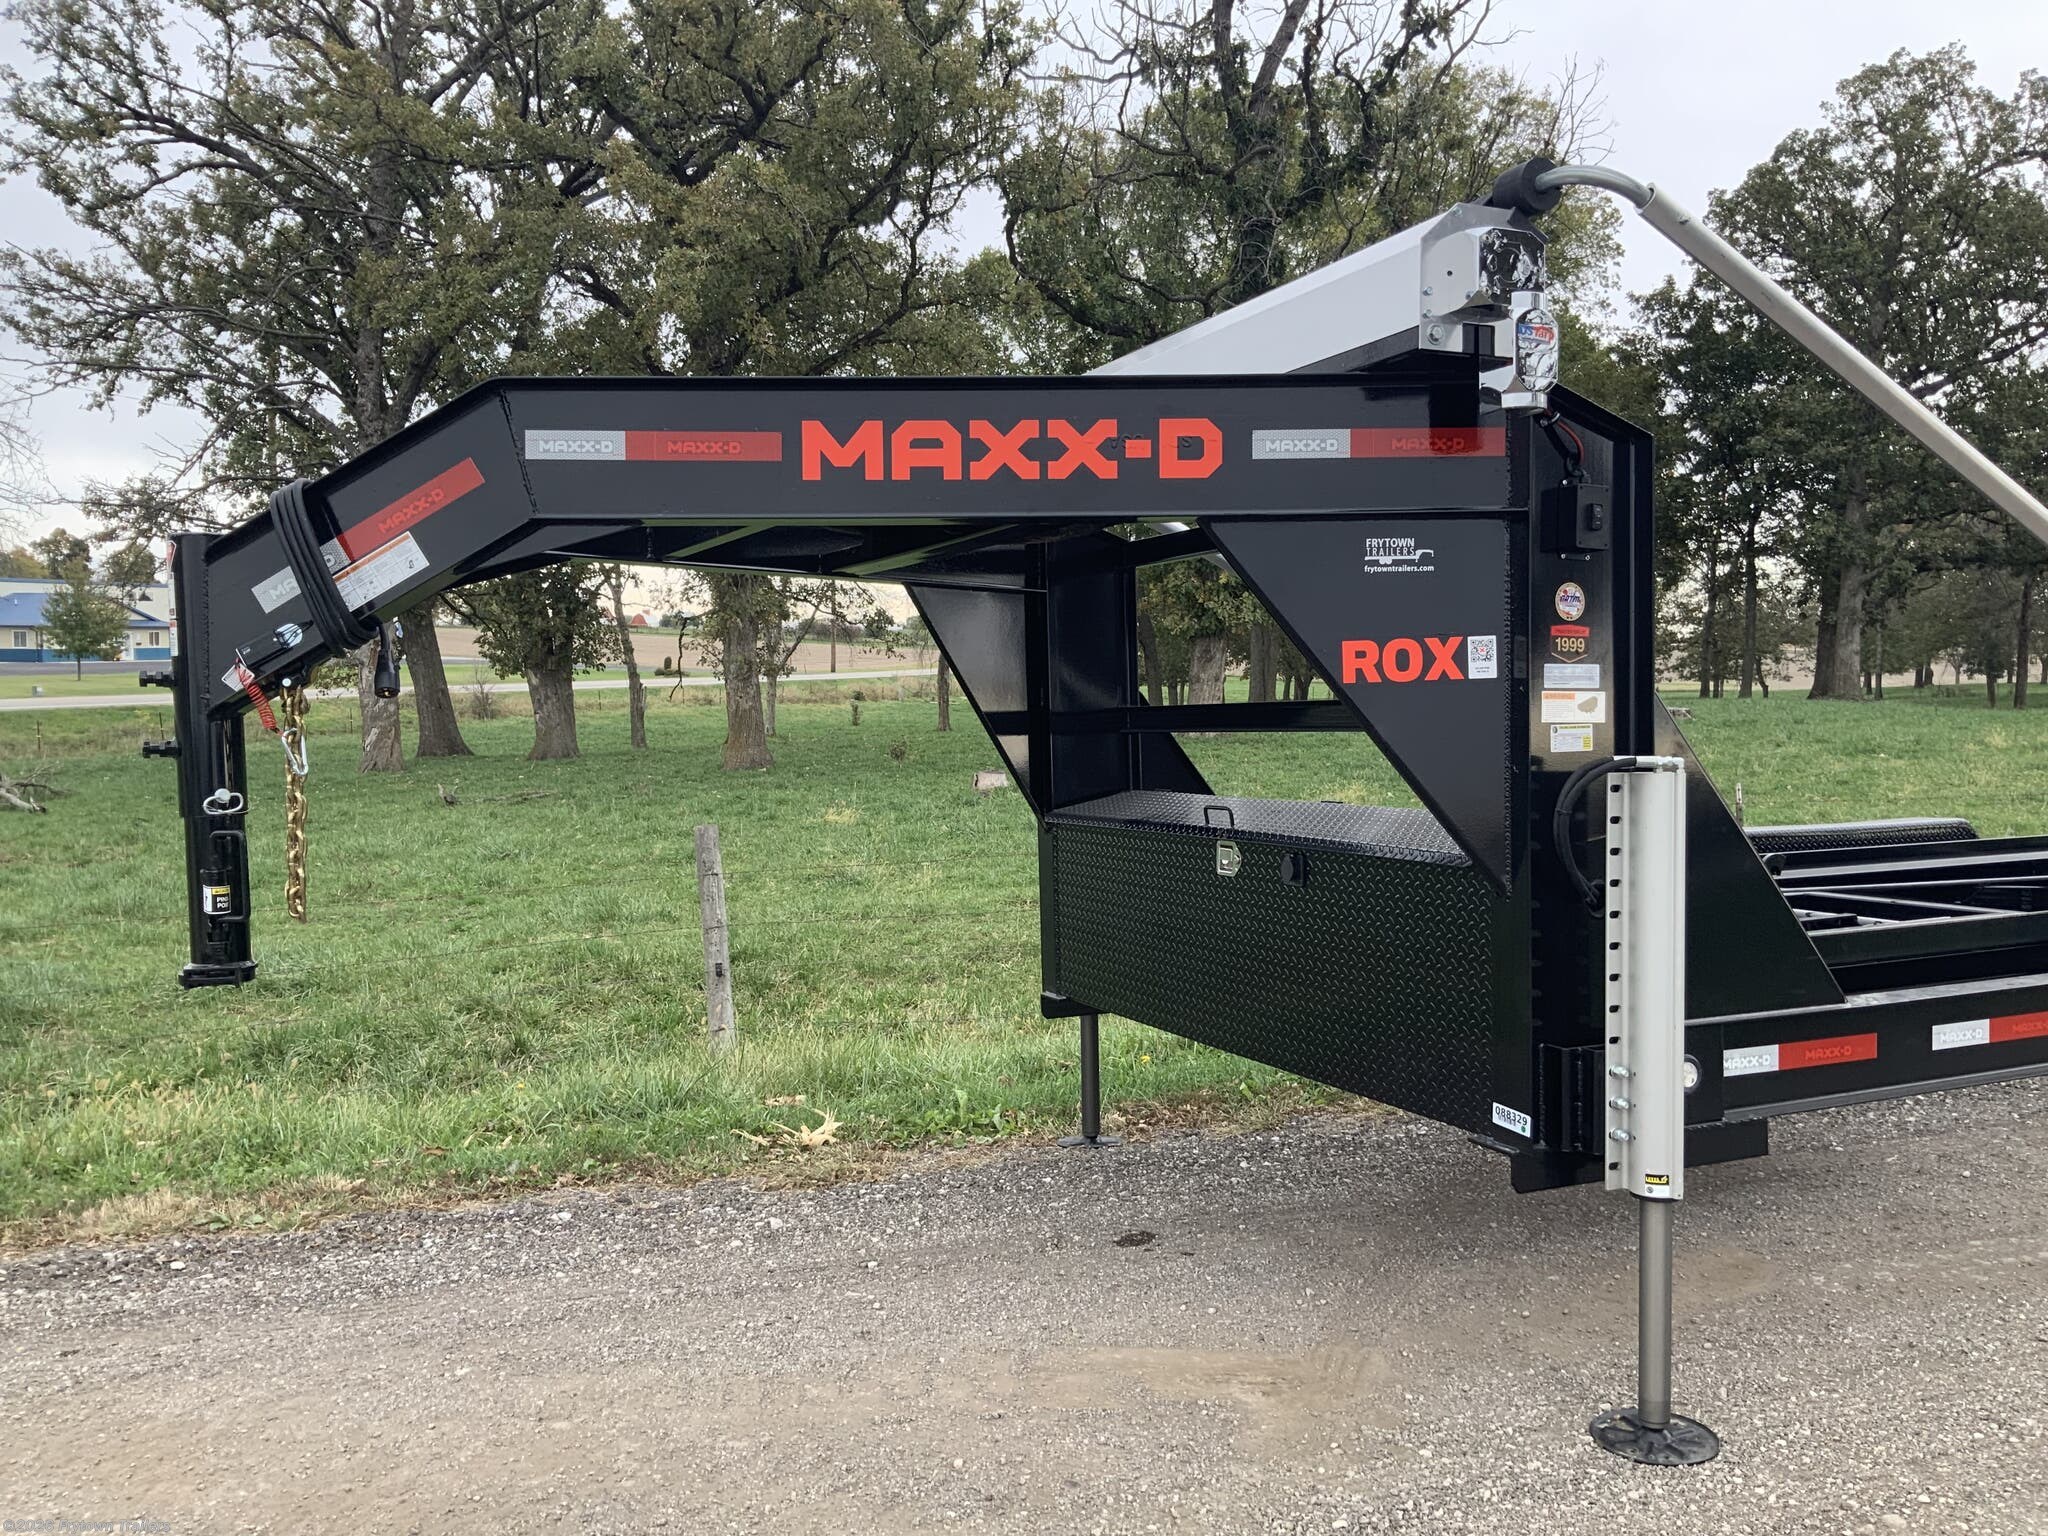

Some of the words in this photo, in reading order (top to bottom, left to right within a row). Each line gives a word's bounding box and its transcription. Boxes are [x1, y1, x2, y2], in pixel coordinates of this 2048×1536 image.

[538, 439, 614, 453] MAXX-D
[667, 440, 741, 454] MAXX-D
[801, 418, 1223, 481] MAXX-D
[1265, 439, 1338, 452] MAXX-D
[1391, 438, 1465, 450] MAXX-D
[377, 488, 445, 534] MAXX-D
[1366, 538, 1415, 548] FRYTOWN
[1366, 547, 1415, 556] TRAILERS
[1364, 564, 1434, 574] frytowntrailers.com
[1556, 637, 1585, 652] 1999
[1341, 636, 1465, 684] ROX
[1940, 1028, 1983, 1043] MAXX-D
[1723, 1054, 1771, 1069] MAXX-D
[1495, 1105, 1528, 1126] 088329
